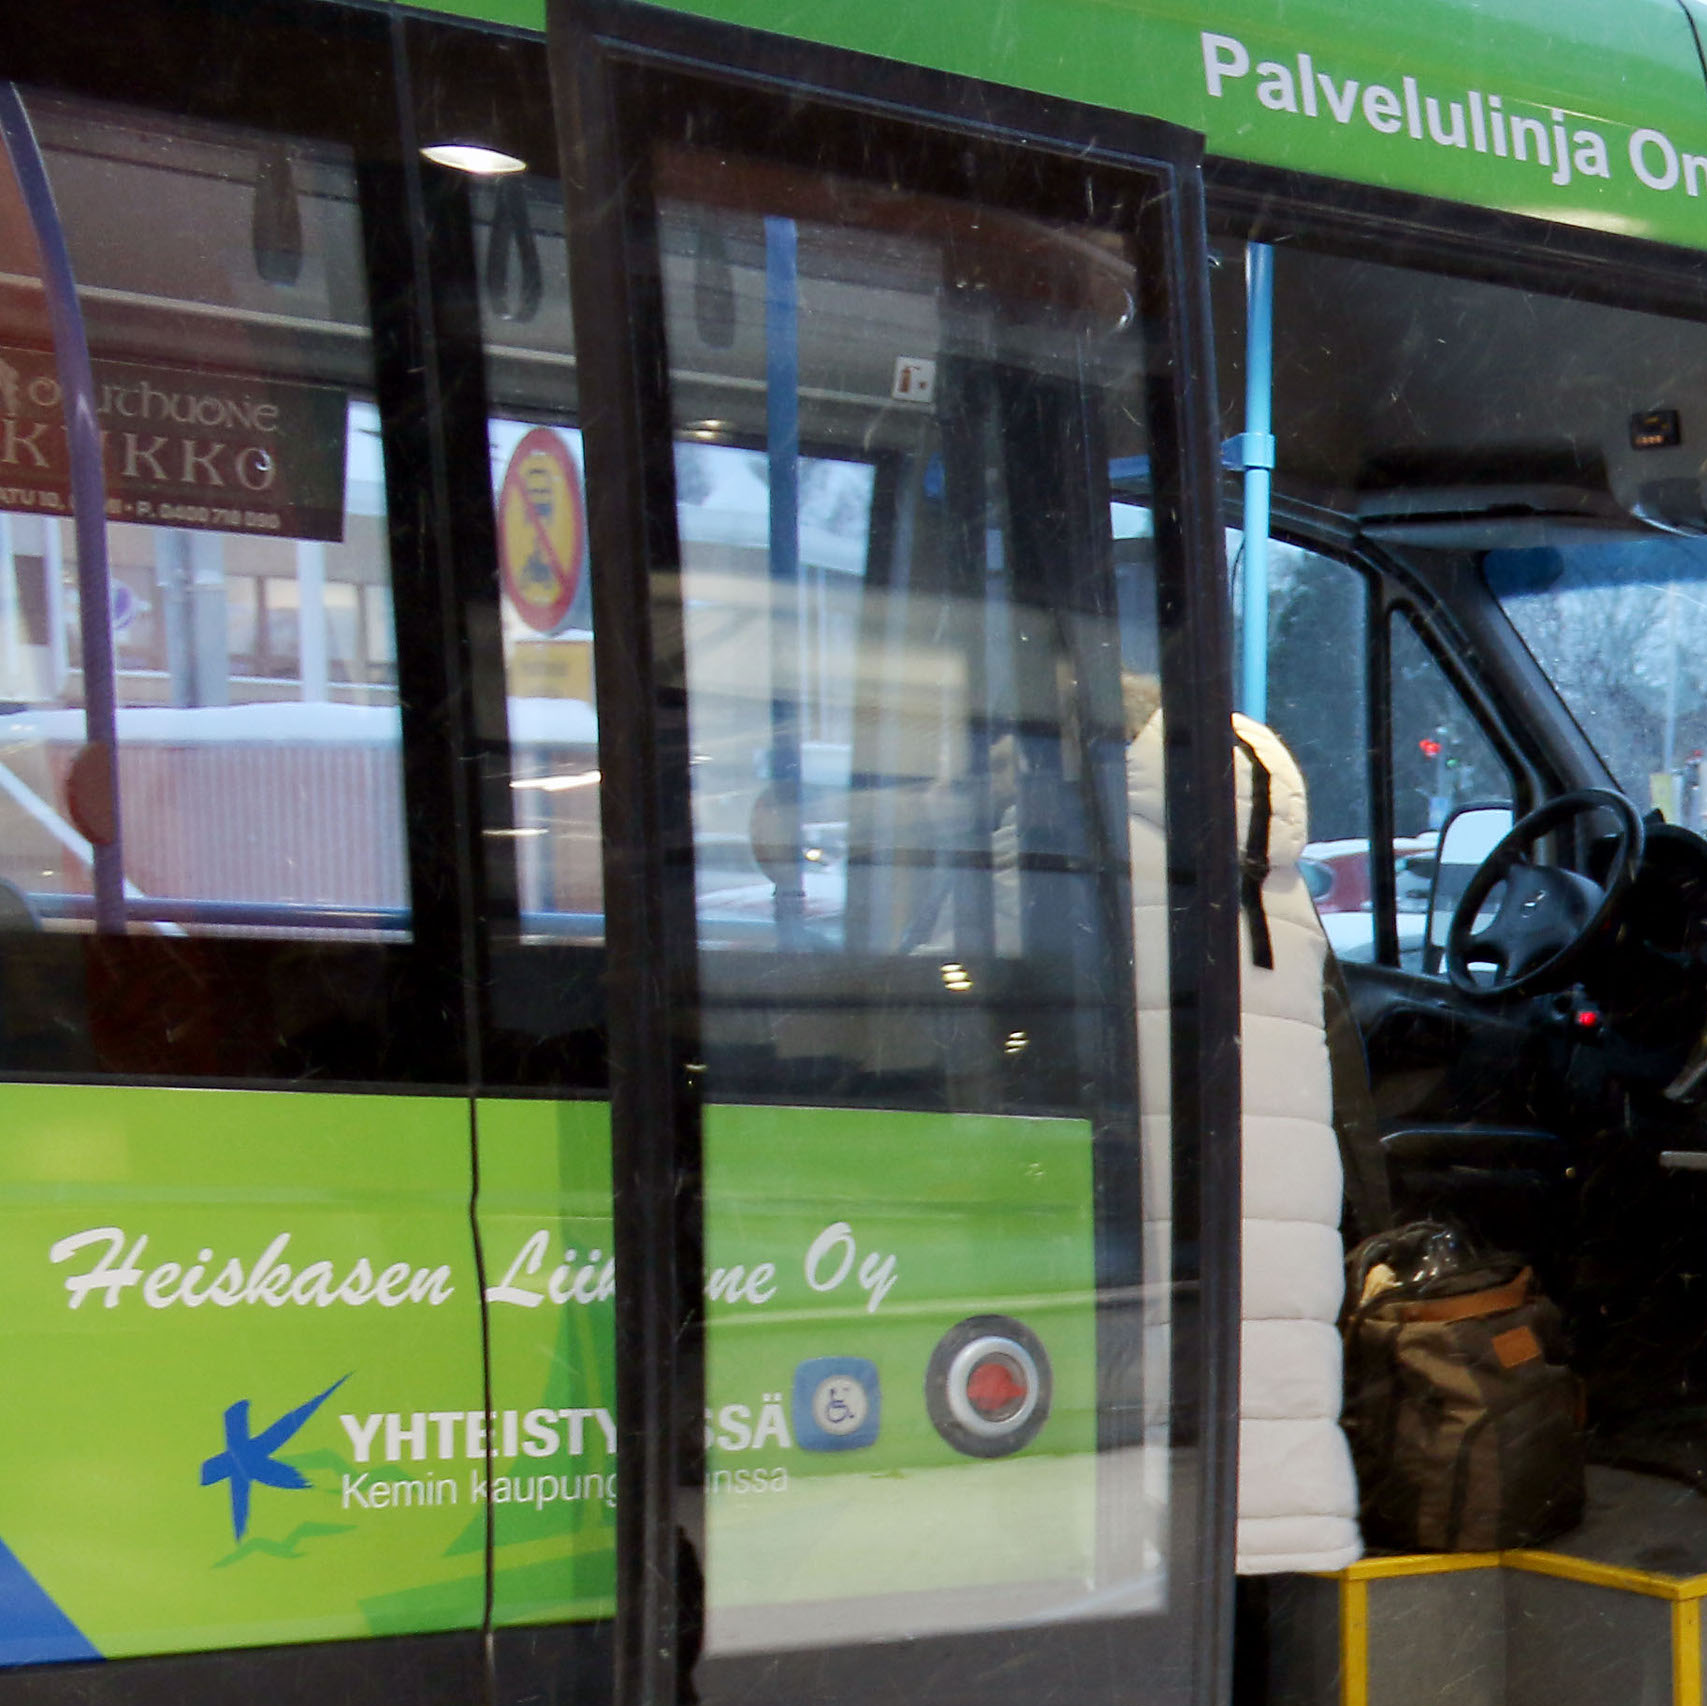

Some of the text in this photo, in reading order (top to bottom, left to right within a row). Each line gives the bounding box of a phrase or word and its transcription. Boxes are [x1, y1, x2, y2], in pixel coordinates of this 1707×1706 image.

[1201, 31, 1609, 186] Palvelulinja
[1, 418, 276, 490] KKKO
[49, 1221, 899, 1314] Heiskasen Liine Oy
[339, 1393, 792, 1462] YHTEISTSÄ
[341, 1466, 788, 1510] Kemin kaupung nssa
